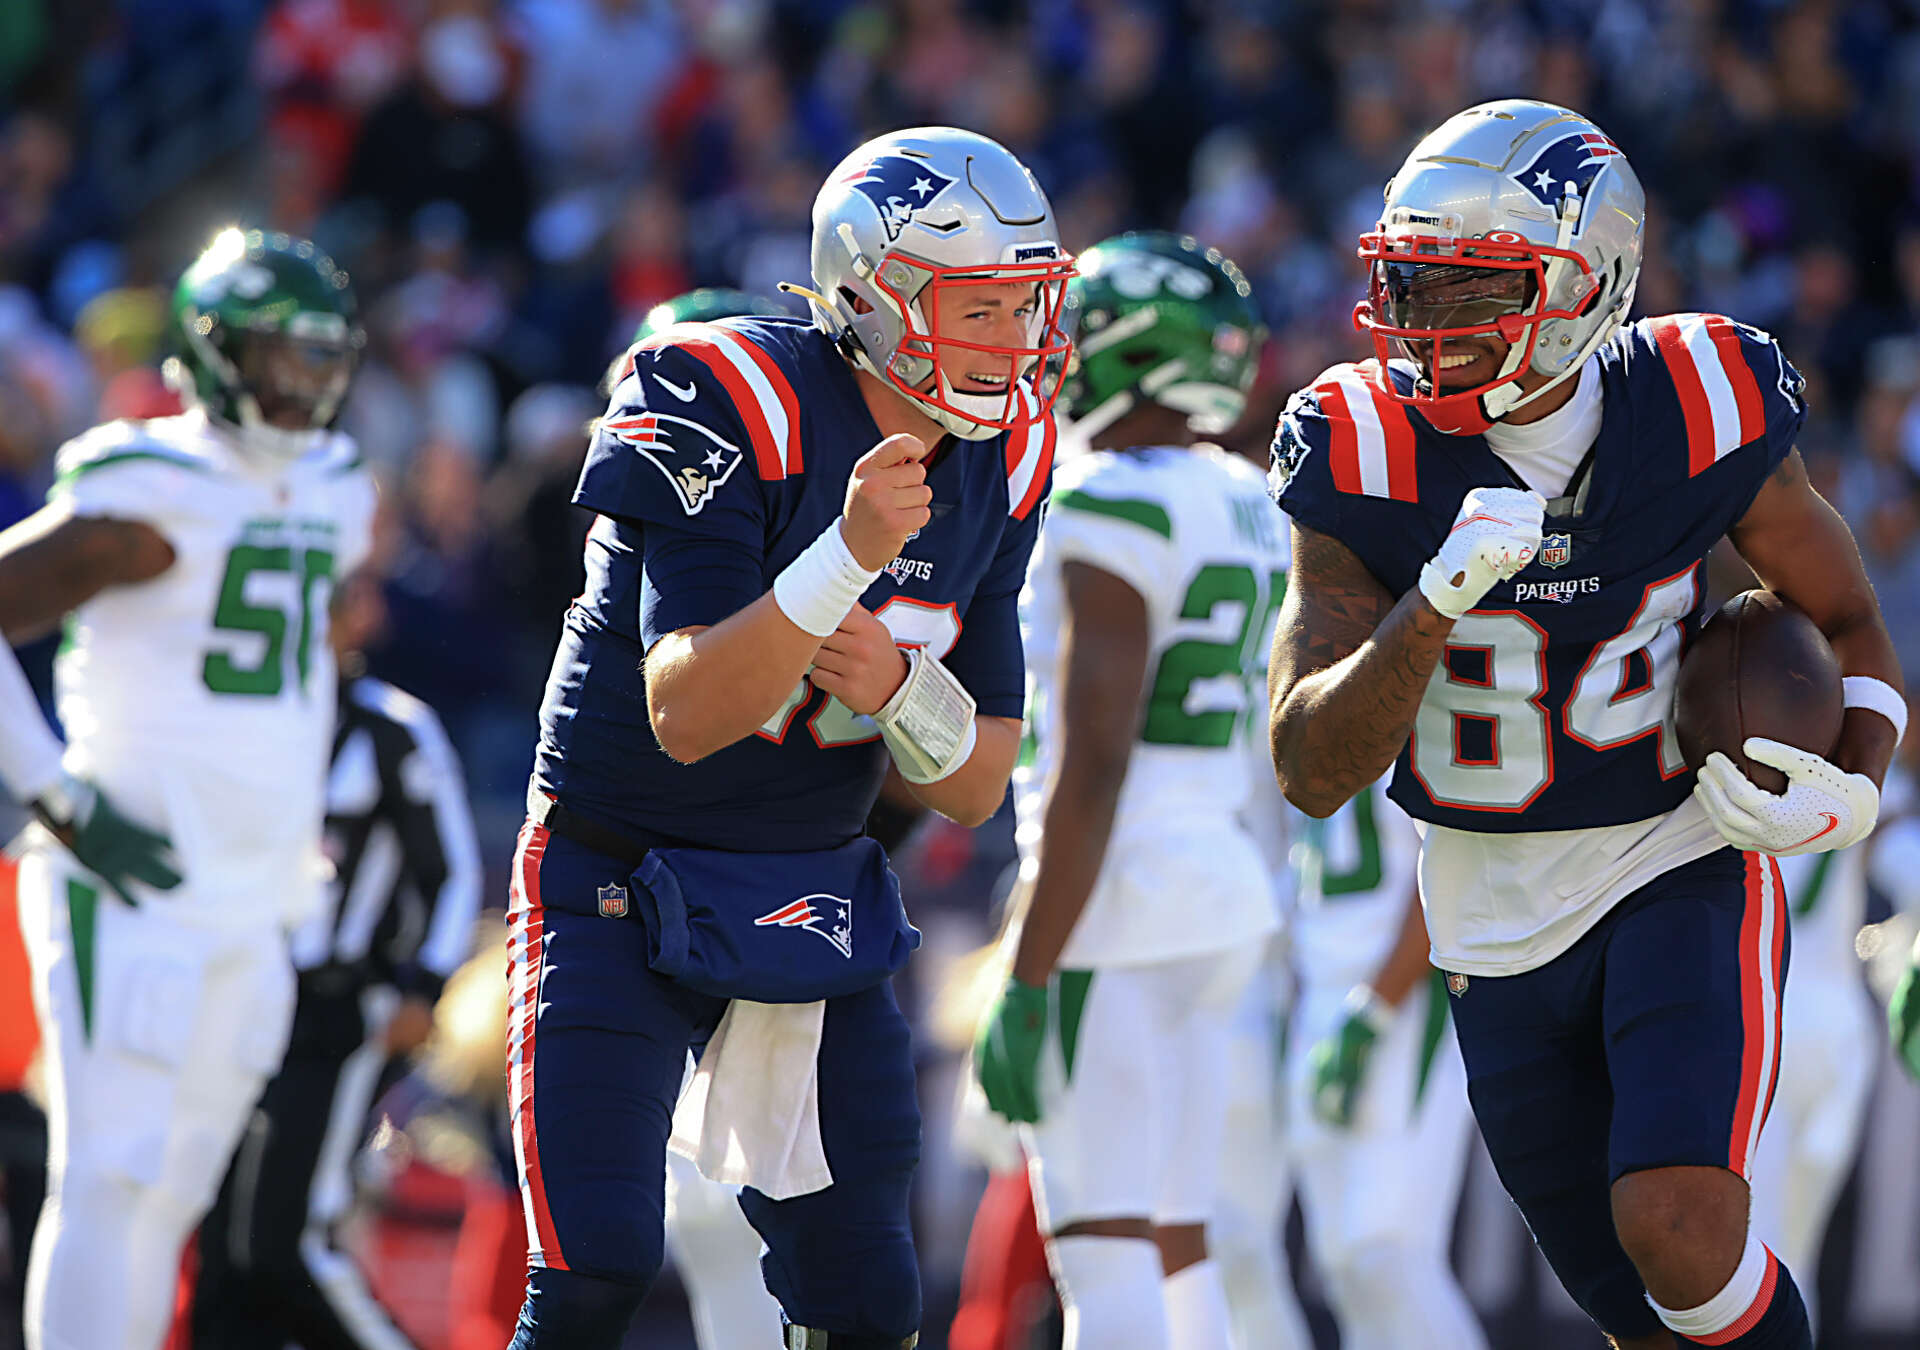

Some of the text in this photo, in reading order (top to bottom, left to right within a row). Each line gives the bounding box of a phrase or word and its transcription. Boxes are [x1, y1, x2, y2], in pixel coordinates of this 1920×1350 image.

[1544, 548, 1567, 563] NFL
[1515, 576, 1600, 603] PATRIOTS
[1410, 559, 1703, 814] 84
[602, 899, 625, 914] NFL
